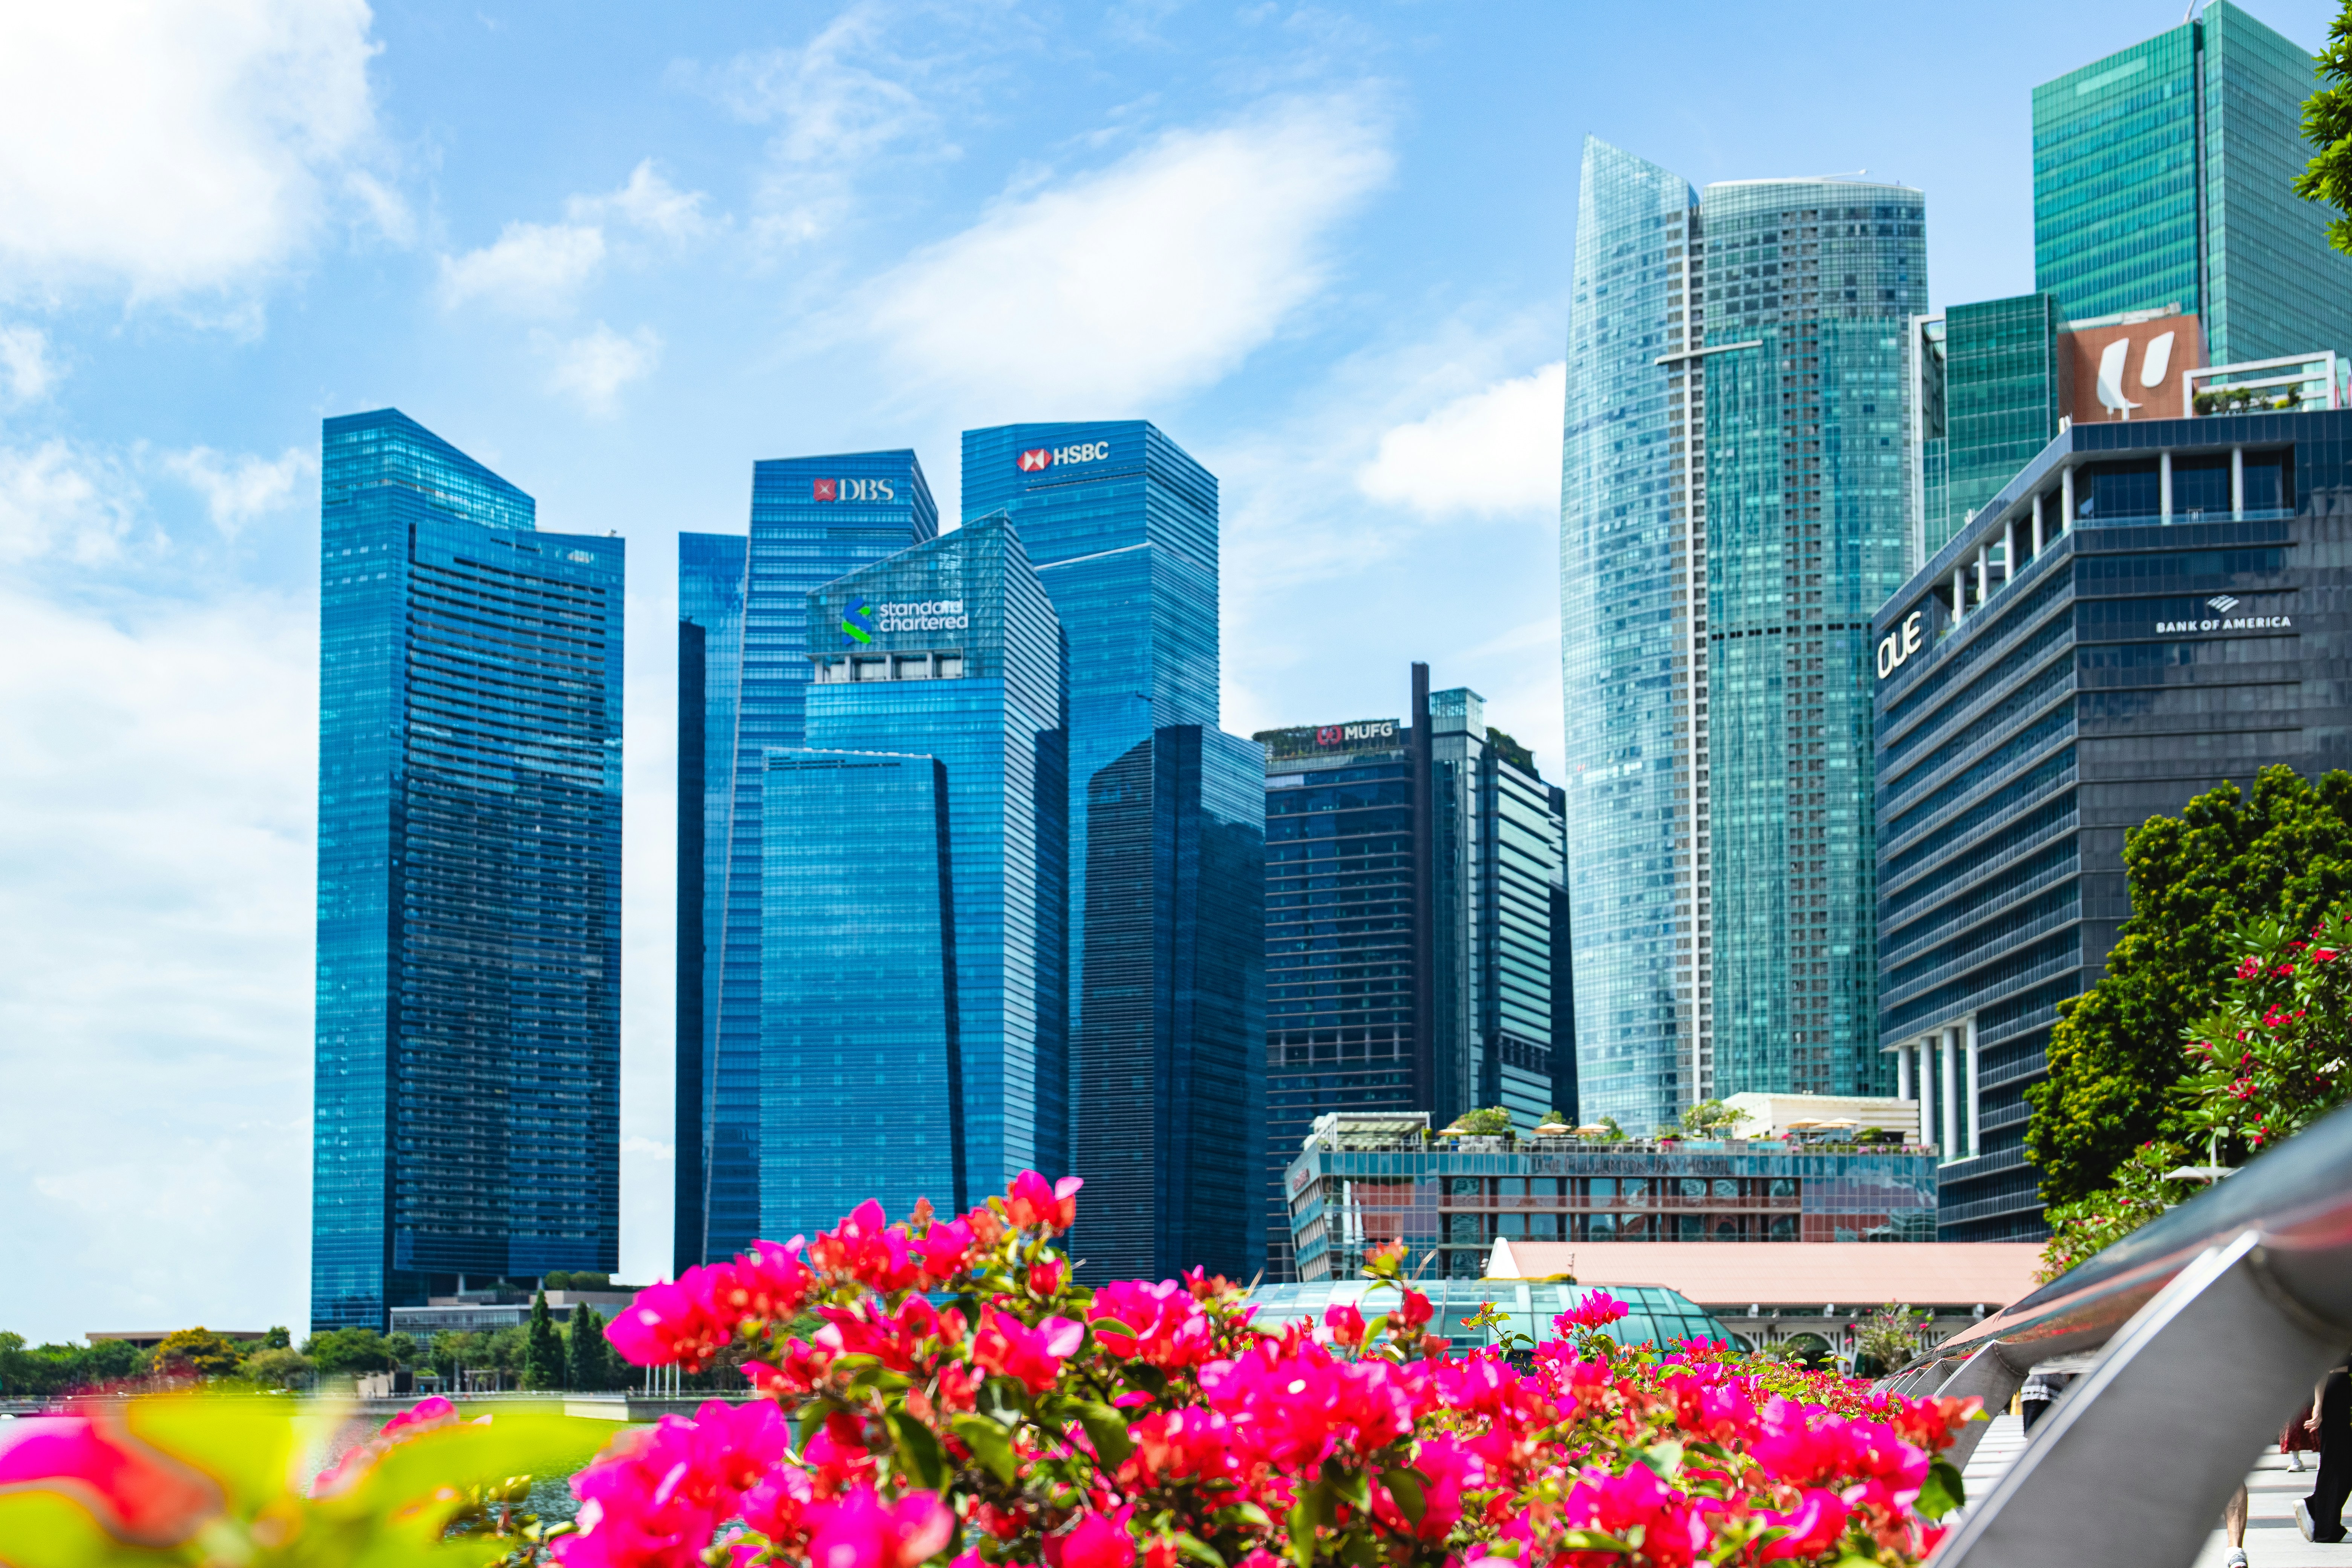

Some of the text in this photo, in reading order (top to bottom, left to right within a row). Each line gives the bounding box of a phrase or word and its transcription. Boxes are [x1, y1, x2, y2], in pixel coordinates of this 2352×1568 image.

[1053, 441, 1109, 466] HSBC
[840, 478, 894, 501] DBS
[879, 598, 963, 617] standard
[879, 611, 968, 632] chartered
[2156, 616, 2291, 633] BANK OF AMERICA
[1877, 611, 1922, 679] OUE
[1344, 722, 1392, 741] MUFG
